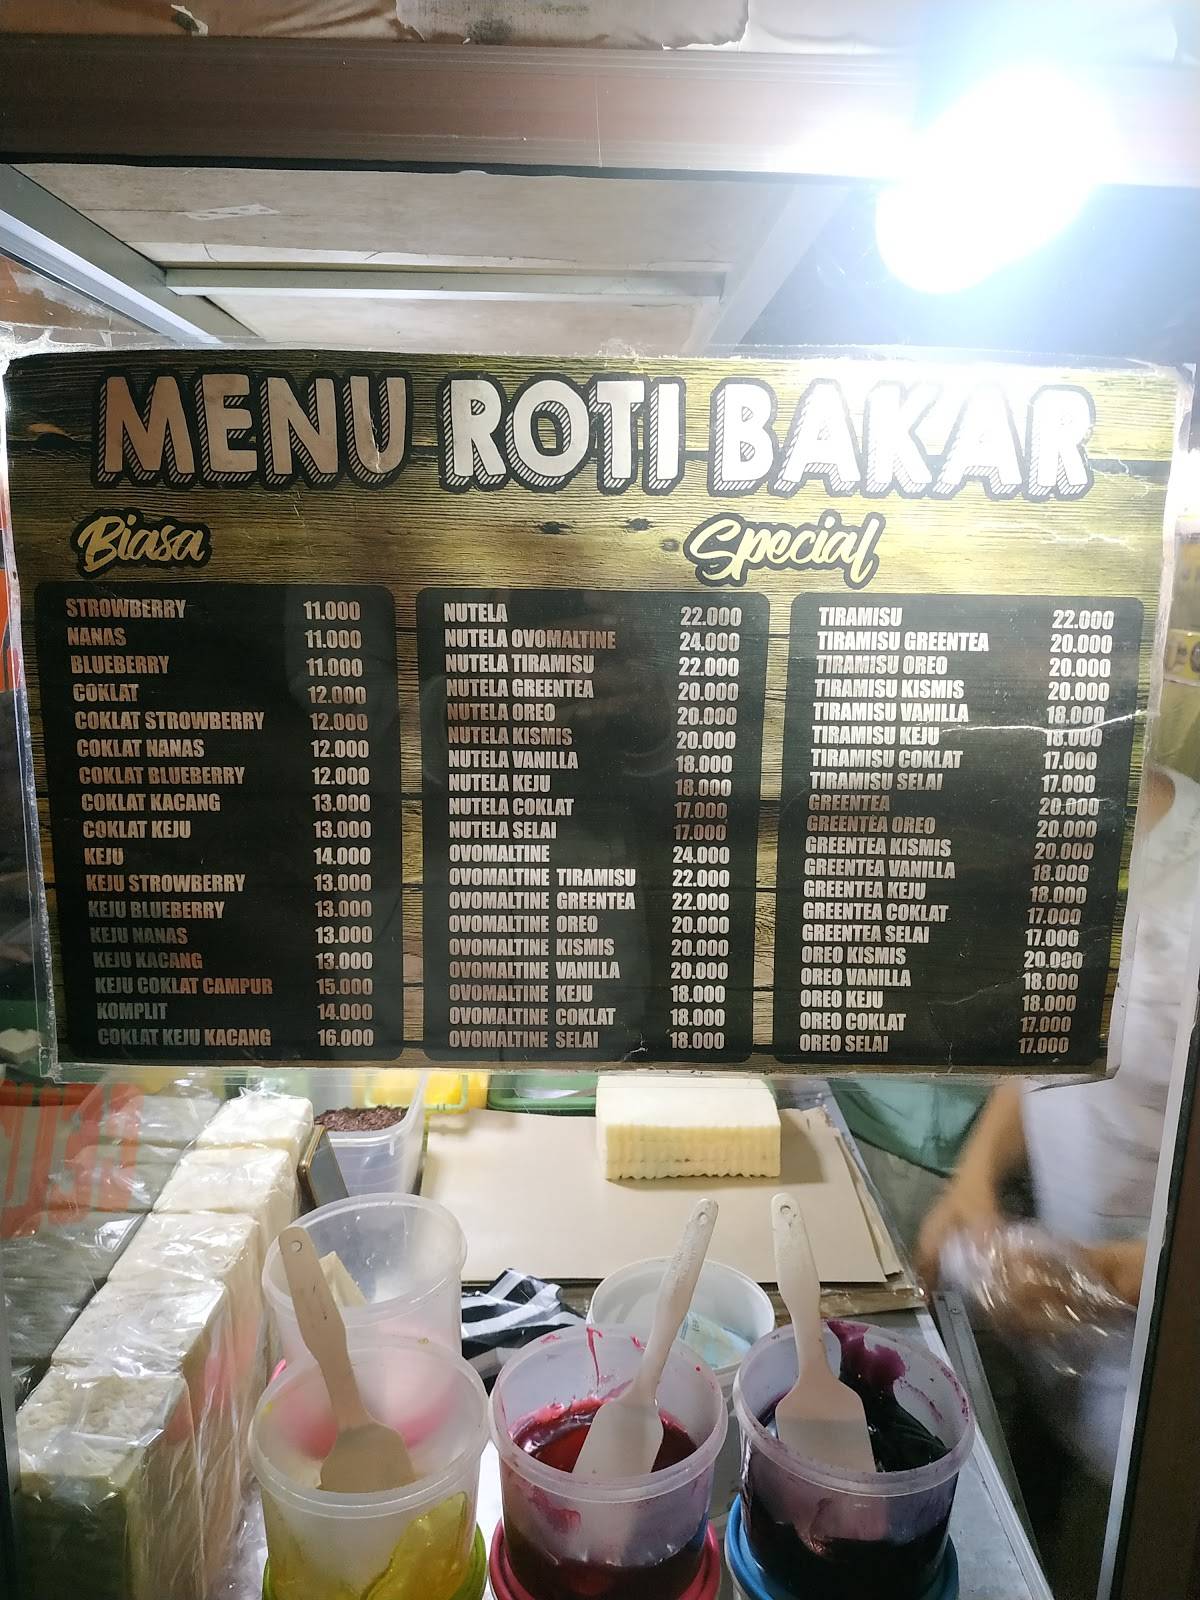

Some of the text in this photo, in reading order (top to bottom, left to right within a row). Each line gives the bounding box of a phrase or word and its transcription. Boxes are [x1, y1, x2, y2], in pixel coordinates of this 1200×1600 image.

[97, 373, 1091, 496] MENU ROTI BAKAR
[77, 514, 206, 573] Biasa
[688, 515, 880, 584] Special
[66, 598, 360, 620] STROWBERRY 11.000
[444, 603, 741, 626] NUTELA 22.000
[819, 607, 1114, 630] TIRAMISU 22.000
[67, 628, 361, 649] NANAS 11.000
[445, 629, 740, 652] NUTELA OVOMALTINE 24.000
[818, 631, 1112, 654] TIRAMISU GREENTEA 20.000
[71, 656, 363, 677] BLUEBERRY 11.000
[445, 655, 739, 677] NUTELA TIRAMISU 22.000
[816, 655, 1111, 677] TIRAMISU OREO 20.000
[73, 684, 367, 704] COKLAT 12.000
[446, 679, 738, 701] NUTELA GREENTEA 20.000
[815, 679, 1109, 701] TIRAMISU KISMIS 20.000
[75, 712, 264, 730] COKLAT STROWBERRY
[448, 704, 737, 725] NUTELA OREO 20.000
[813, 702, 1105, 725] TIRAMISU VANILLA 18.000
[448, 727, 736, 750] NUTELA KISMIS 20.000
[812, 726, 939, 745] TIRAMISU KEJU
[77, 740, 369, 758] COKLAT NANAS 12.000
[811, 749, 1097, 770] TIRAMISU COKLAT 17.000
[448, 751, 732, 773] NUTELA VANILLA 18.000
[79, 767, 370, 785] COKLAT BLUEBERRY 12.000
[449, 775, 731, 796] NUTELA KEJU 18.000
[810, 772, 1096, 793] TIRAMISU SELAI 17.000
[82, 794, 370, 812] COKLAT KACANG 13.000
[449, 799, 574, 816] NUTELA COKLAT
[809, 794, 1099, 816] GREENTEA 20.000
[83, 821, 371, 838] COKLAT KEJU 13.000
[449, 822, 556, 839] NUTELA SELAI
[1036, 820, 1097, 838] 20.000
[85, 848, 370, 865] KEJU 14.000
[449, 845, 730, 864] OVOMALTINE 24.000
[806, 837, 1094, 860] GREENTEA KISMIS 20.000
[449, 869, 730, 887] OVOMALTINE TIRAMISU 22.000
[804, 859, 1089, 882] GREENTEA VANILLA 18.000
[87, 874, 371, 892] KEJU STROWBERRY 13.000
[804, 881, 1087, 904] GREENTEA KEJU 18.000
[88, 900, 372, 919] KEJU BLUEBERRY 13.000
[449, 892, 729, 910] OVOMALTINE GREENTEA 22.000
[803, 902, 1081, 925] GREENTEA COKLAT 17.000
[449, 915, 729, 934] OVOMALTINE OREO 20.000
[315, 927, 372, 944] 13.000
[802, 924, 1079, 947] GREENTEA SELAI 17.000
[449, 939, 728, 957] OVOMALTINE KISMIS 20.000
[801, 946, 1083, 969] OREO KISMIS 20.000
[315, 952, 372, 969] 13.000
[449, 962, 728, 980] OVOMALTINE VANILLA 20.000
[95, 978, 372, 995] KEJU COKLAT CAMPUR 15.000
[801, 968, 1078, 990] OREO VANILLA 18.000
[449, 985, 725, 1003] OVOMALTINE KEJU 18.000
[801, 990, 1076, 1011] OREO KEJU 18.000
[97, 1003, 372, 1020] KOMPLIT 14.000
[449, 1008, 725, 1026] OVOMALTINE COKLAT 18.000
[800, 1012, 906, 1031] OREO COKLAT
[317, 1029, 373, 1046] 16.000
[449, 1031, 724, 1049] OVOMALTINE SELAI 18.000
[799, 1034, 888, 1052] OREO SELAI
